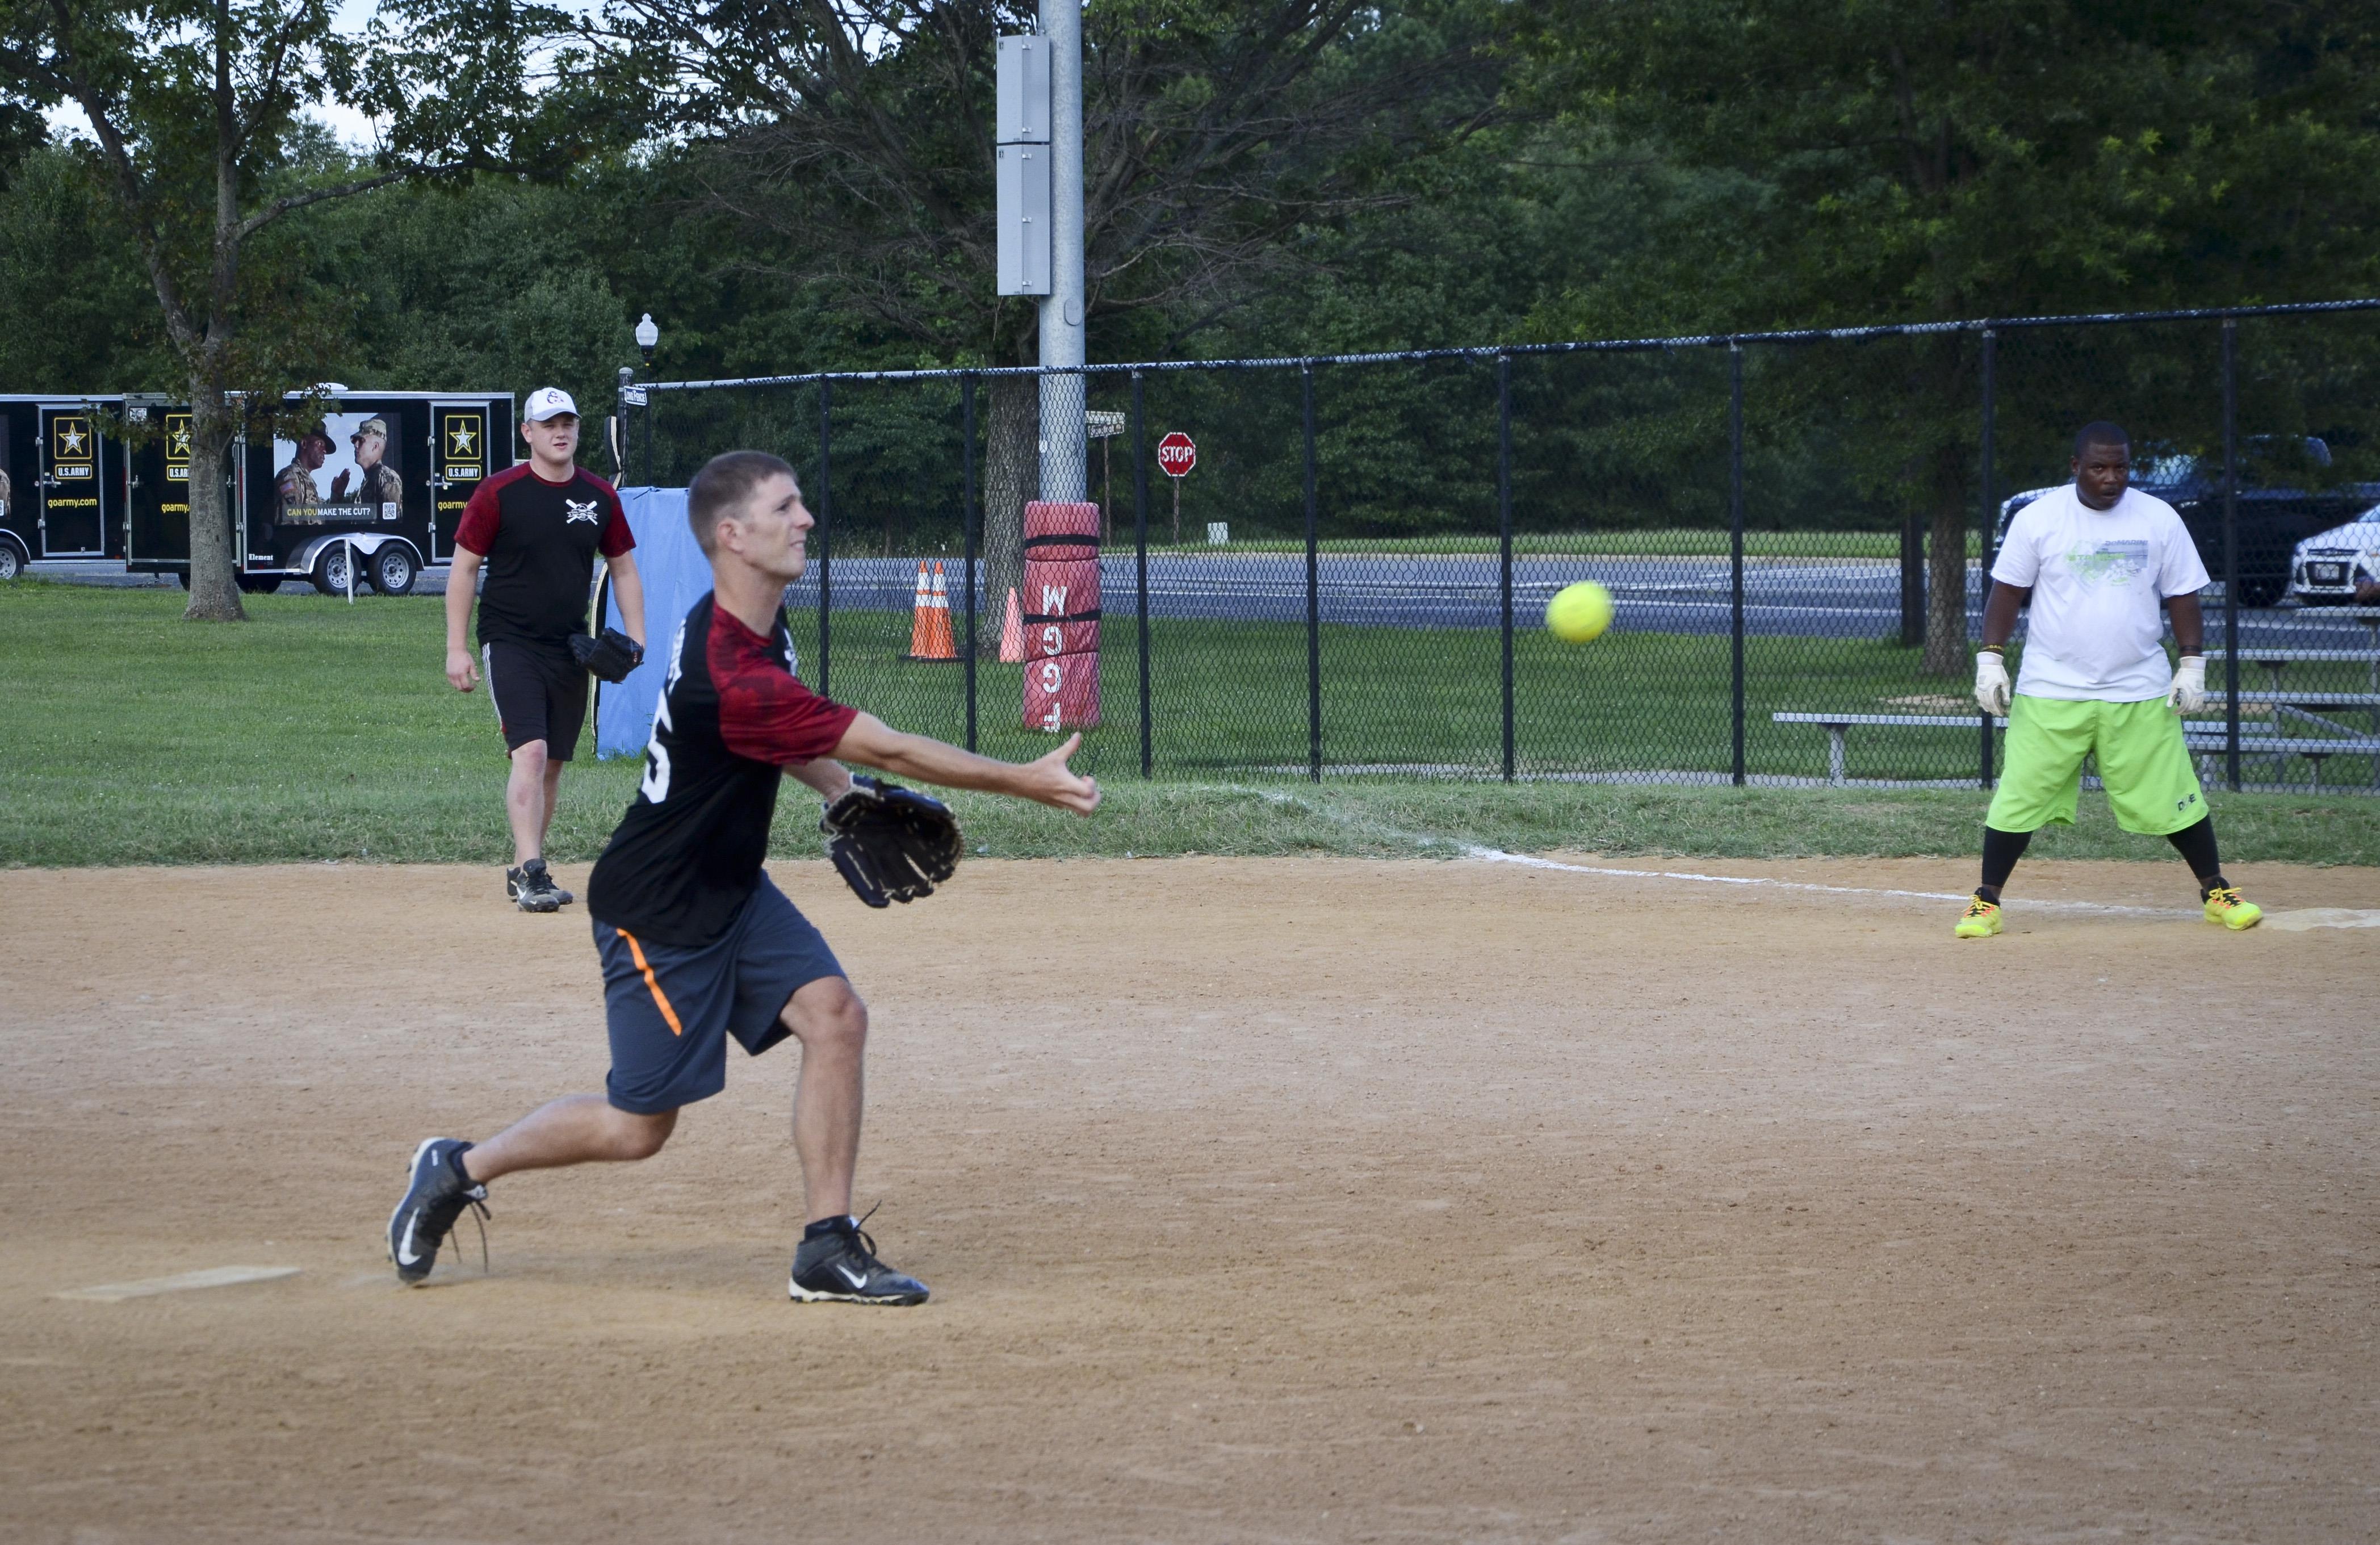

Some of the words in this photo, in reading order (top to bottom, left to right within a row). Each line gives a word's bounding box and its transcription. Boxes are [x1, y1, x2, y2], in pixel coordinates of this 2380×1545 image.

[1162, 446, 1193, 462] STOP
[58, 467, 89, 476] U.S.ARMY
[169, 468, 188, 478] U.S.AR
[449, 468, 478, 477] U.S.ARMY
[48, 498, 97, 508] goarmy.com
[161, 503, 190, 513] goarmy.
[438, 501, 467, 512] goarmy
